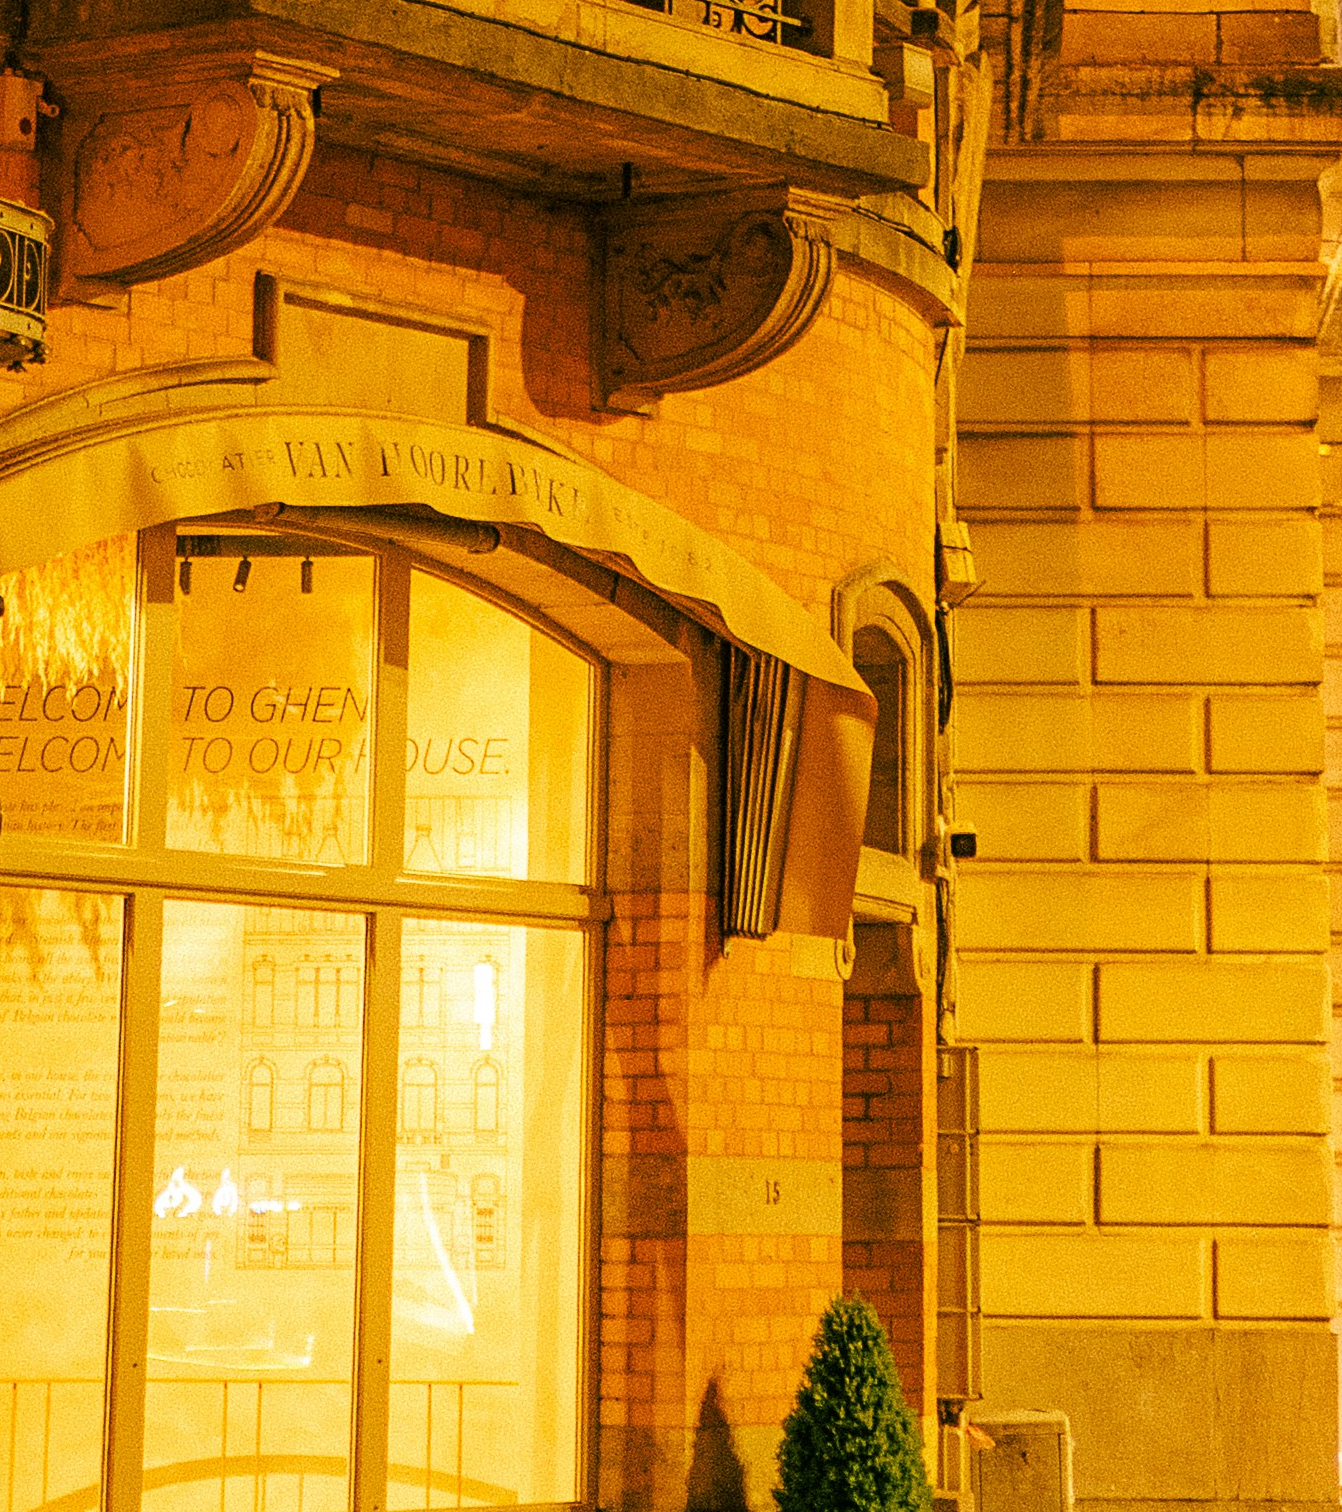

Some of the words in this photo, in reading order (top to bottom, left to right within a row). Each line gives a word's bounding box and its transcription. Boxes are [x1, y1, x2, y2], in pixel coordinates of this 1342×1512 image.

[284, 441, 353, 478] VAN
[182, 685, 235, 723] TO
[249, 685, 369, 724] GHEN
[182, 736, 233, 774] TO
[248, 737, 343, 775] OUR
[765, 1179, 780, 1205] 15
